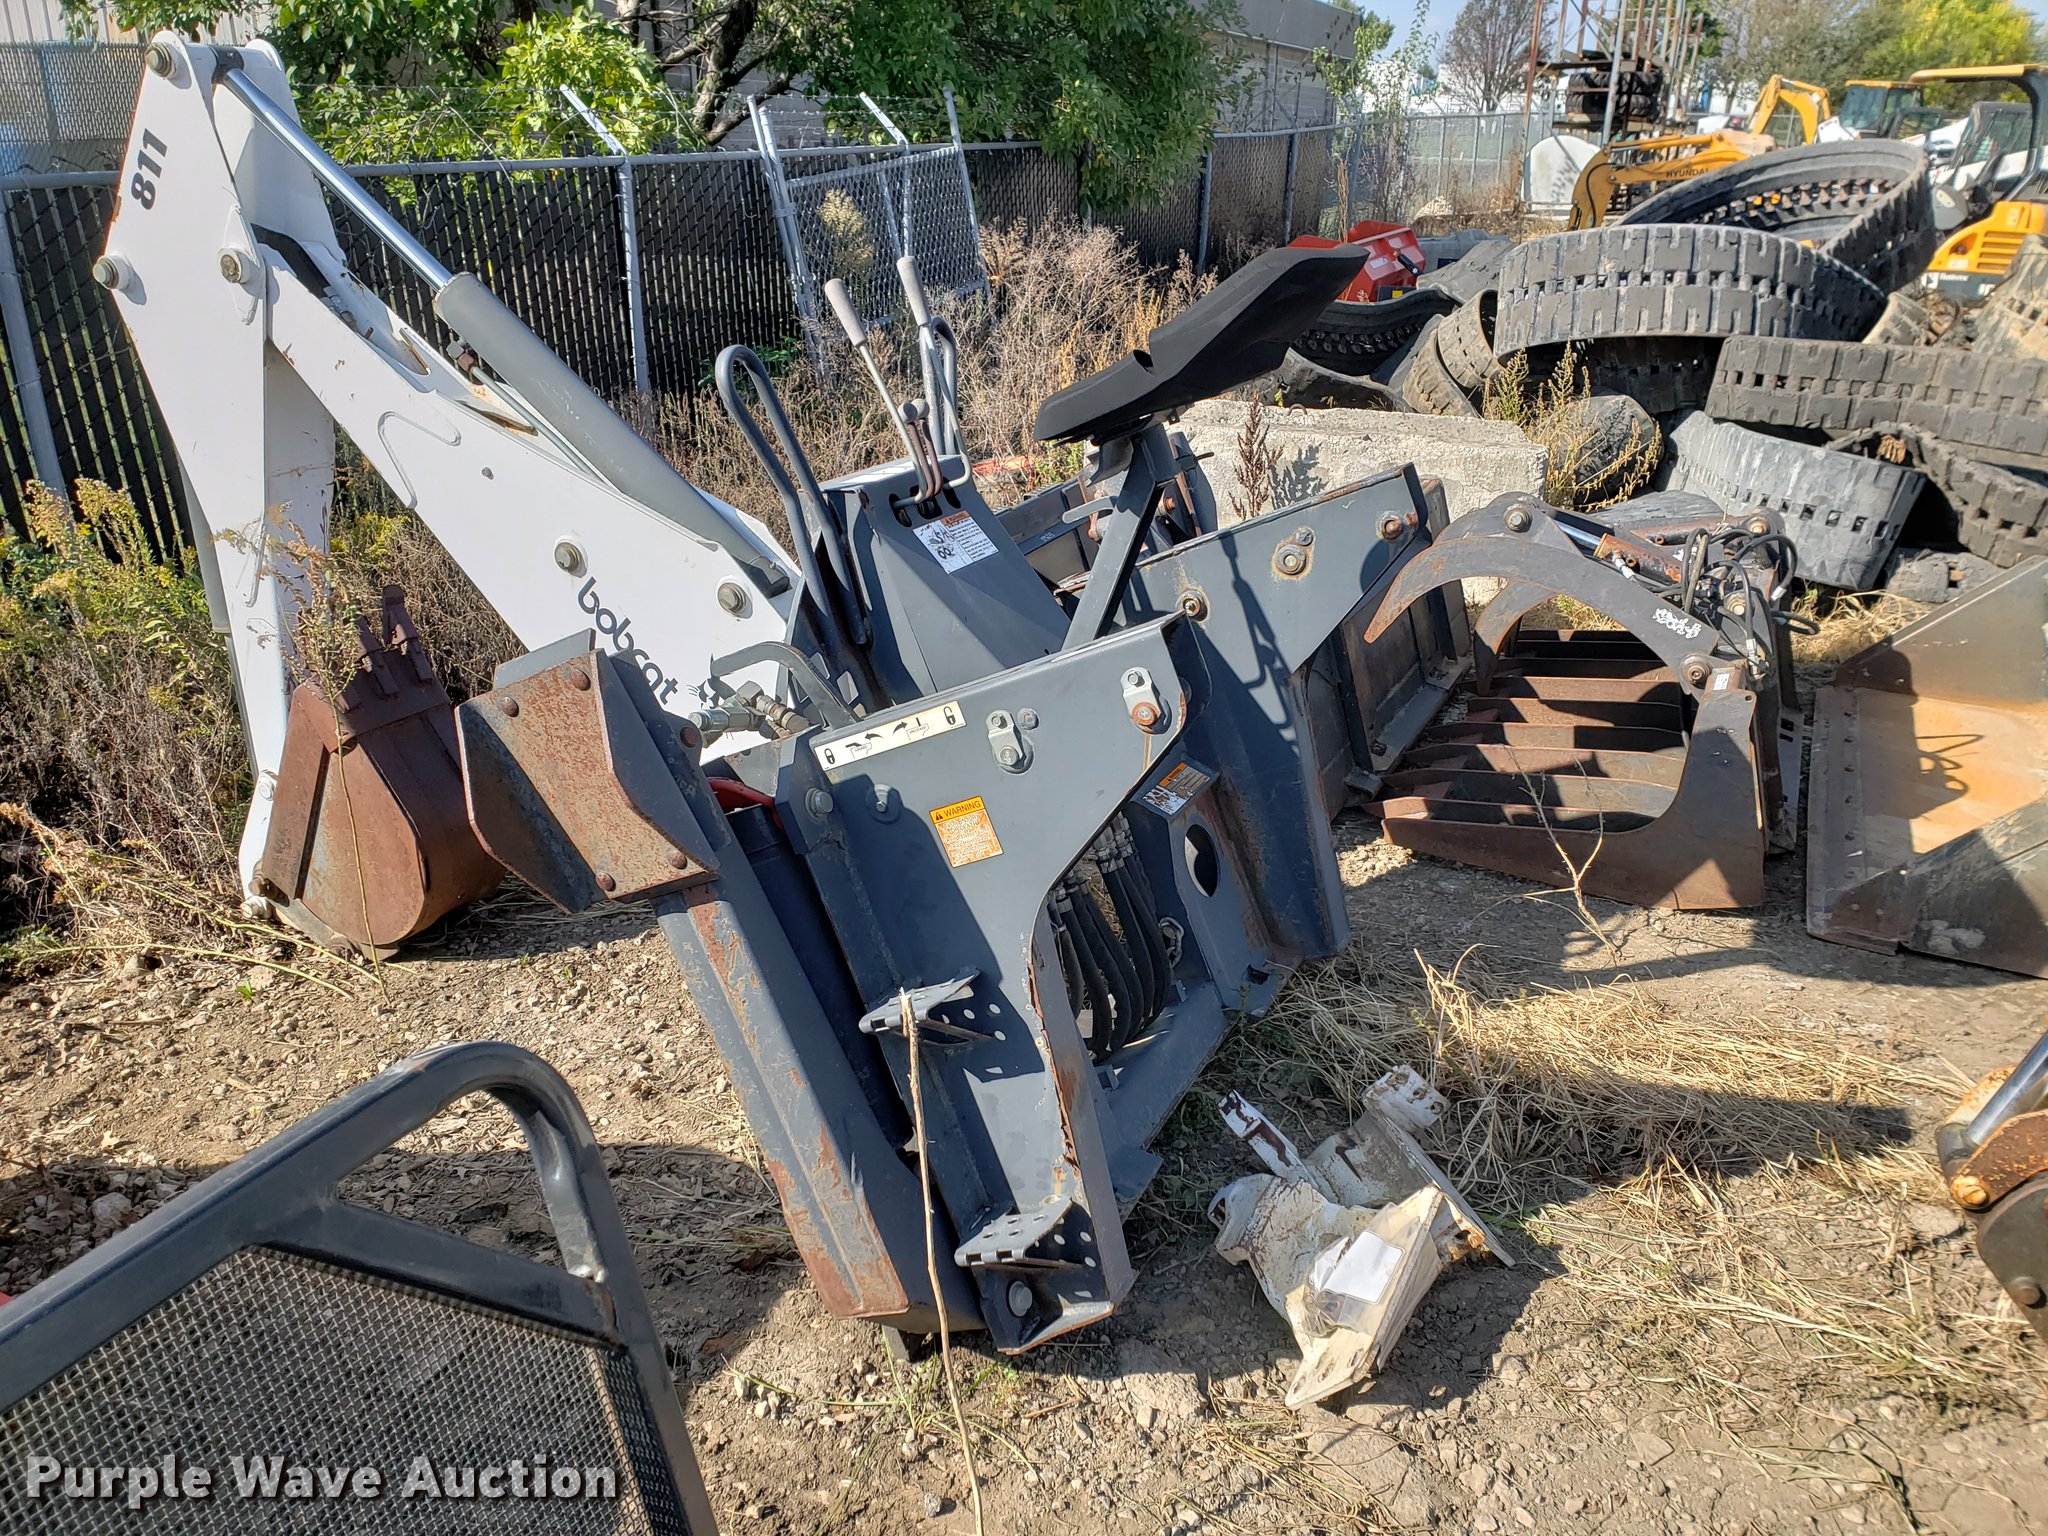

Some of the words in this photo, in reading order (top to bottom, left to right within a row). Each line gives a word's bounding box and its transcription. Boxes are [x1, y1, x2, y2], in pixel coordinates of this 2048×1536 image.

[131, 128, 167, 210] 811
[1666, 168, 1709, 178] HYUNDAI
[578, 576, 679, 705] bobcat
[943, 800, 981, 817] WARNING
